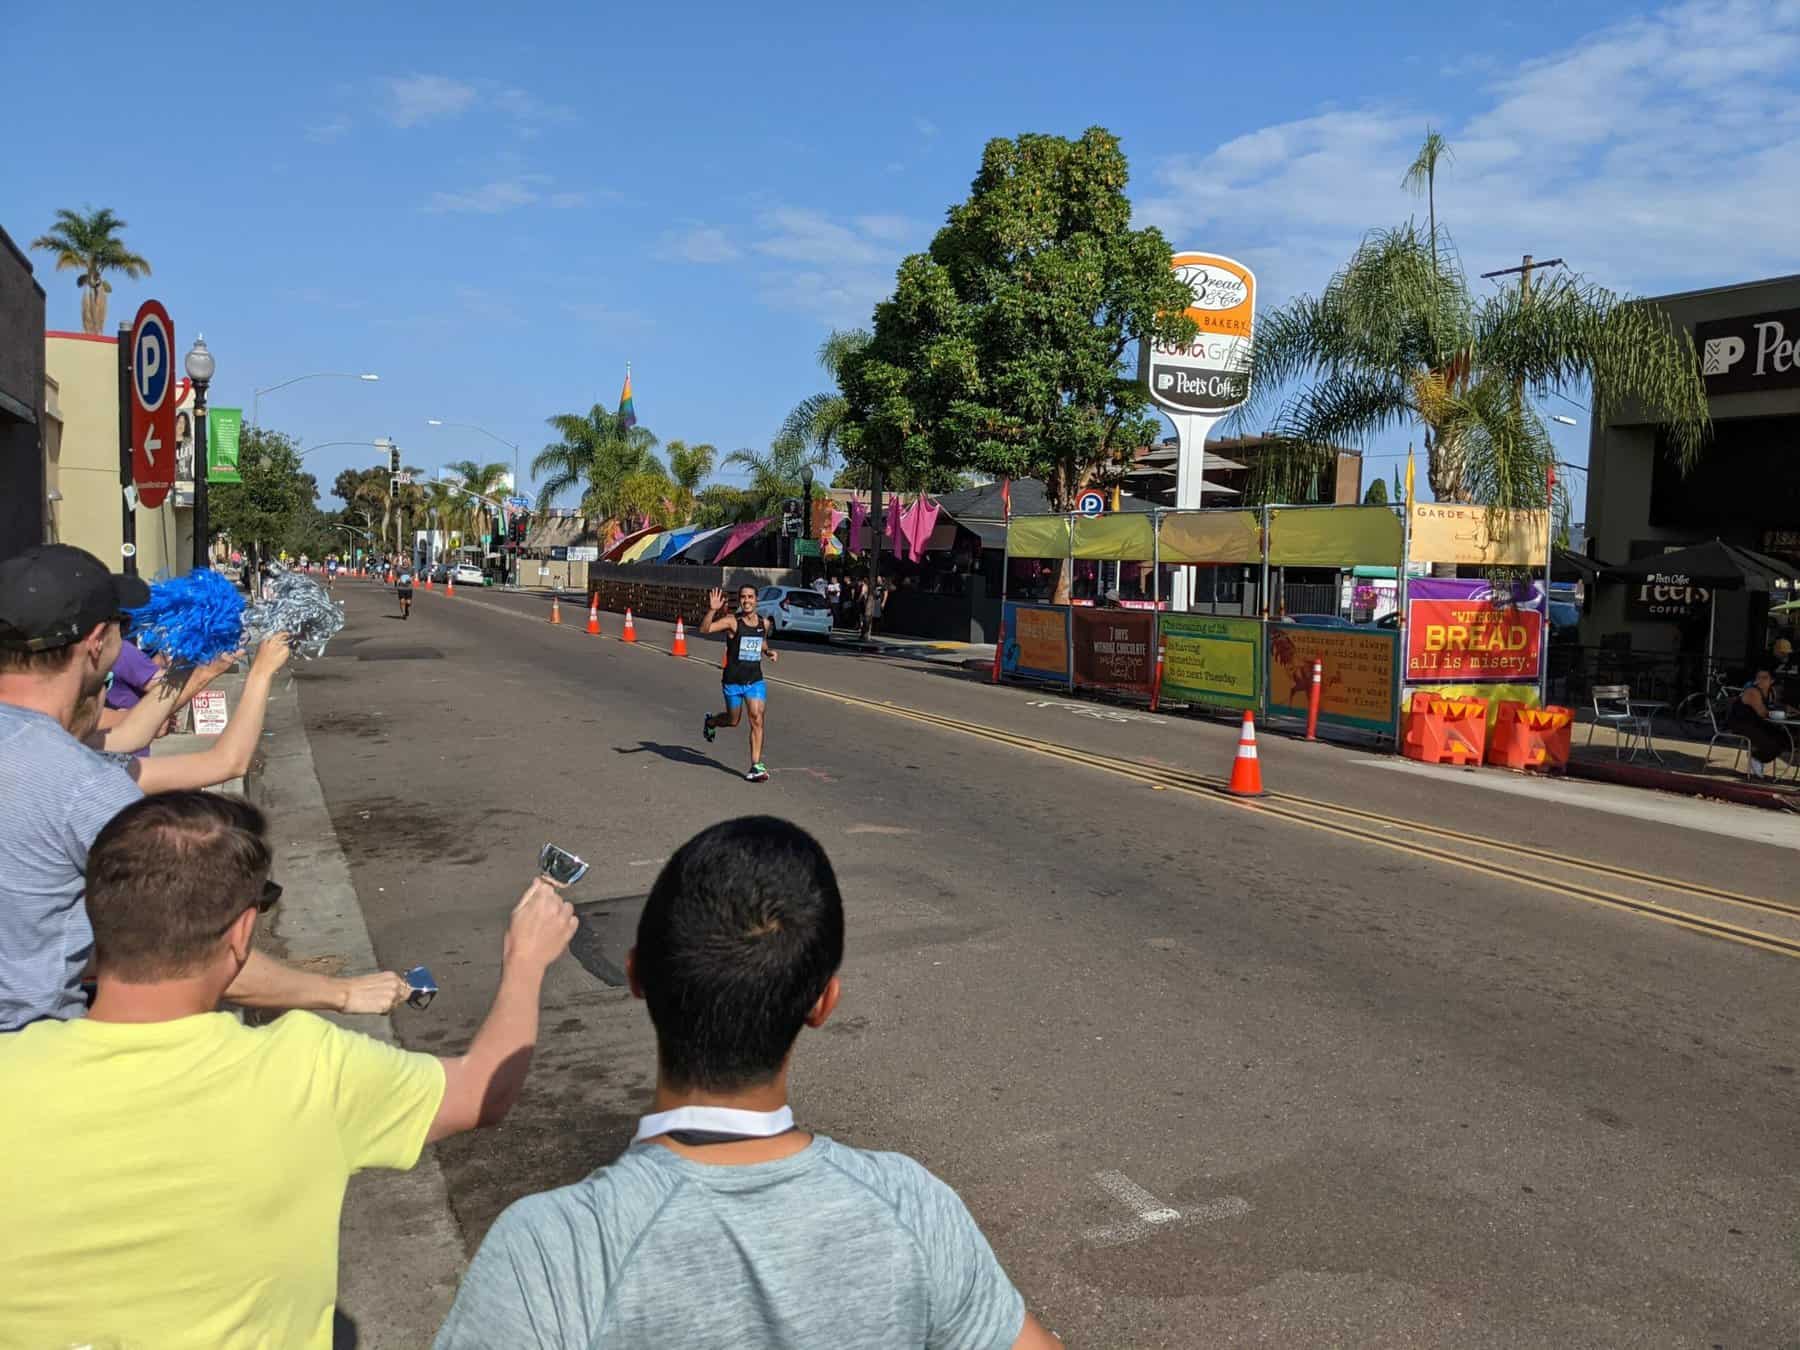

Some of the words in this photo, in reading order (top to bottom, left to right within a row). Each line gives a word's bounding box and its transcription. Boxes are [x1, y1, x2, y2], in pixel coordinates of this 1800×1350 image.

[1174, 266, 1248, 302] Bread
[1204, 316, 1247, 329] BAKERY
[141, 335, 161, 396] P
[1085, 498, 1098, 512] P
[1417, 507, 1465, 520] GARDE
[1425, 624, 1528, 651] BREAD
[1410, 653, 1438, 669] all
[1443, 653, 1462, 669] is
[195, 698, 209, 708] NO
